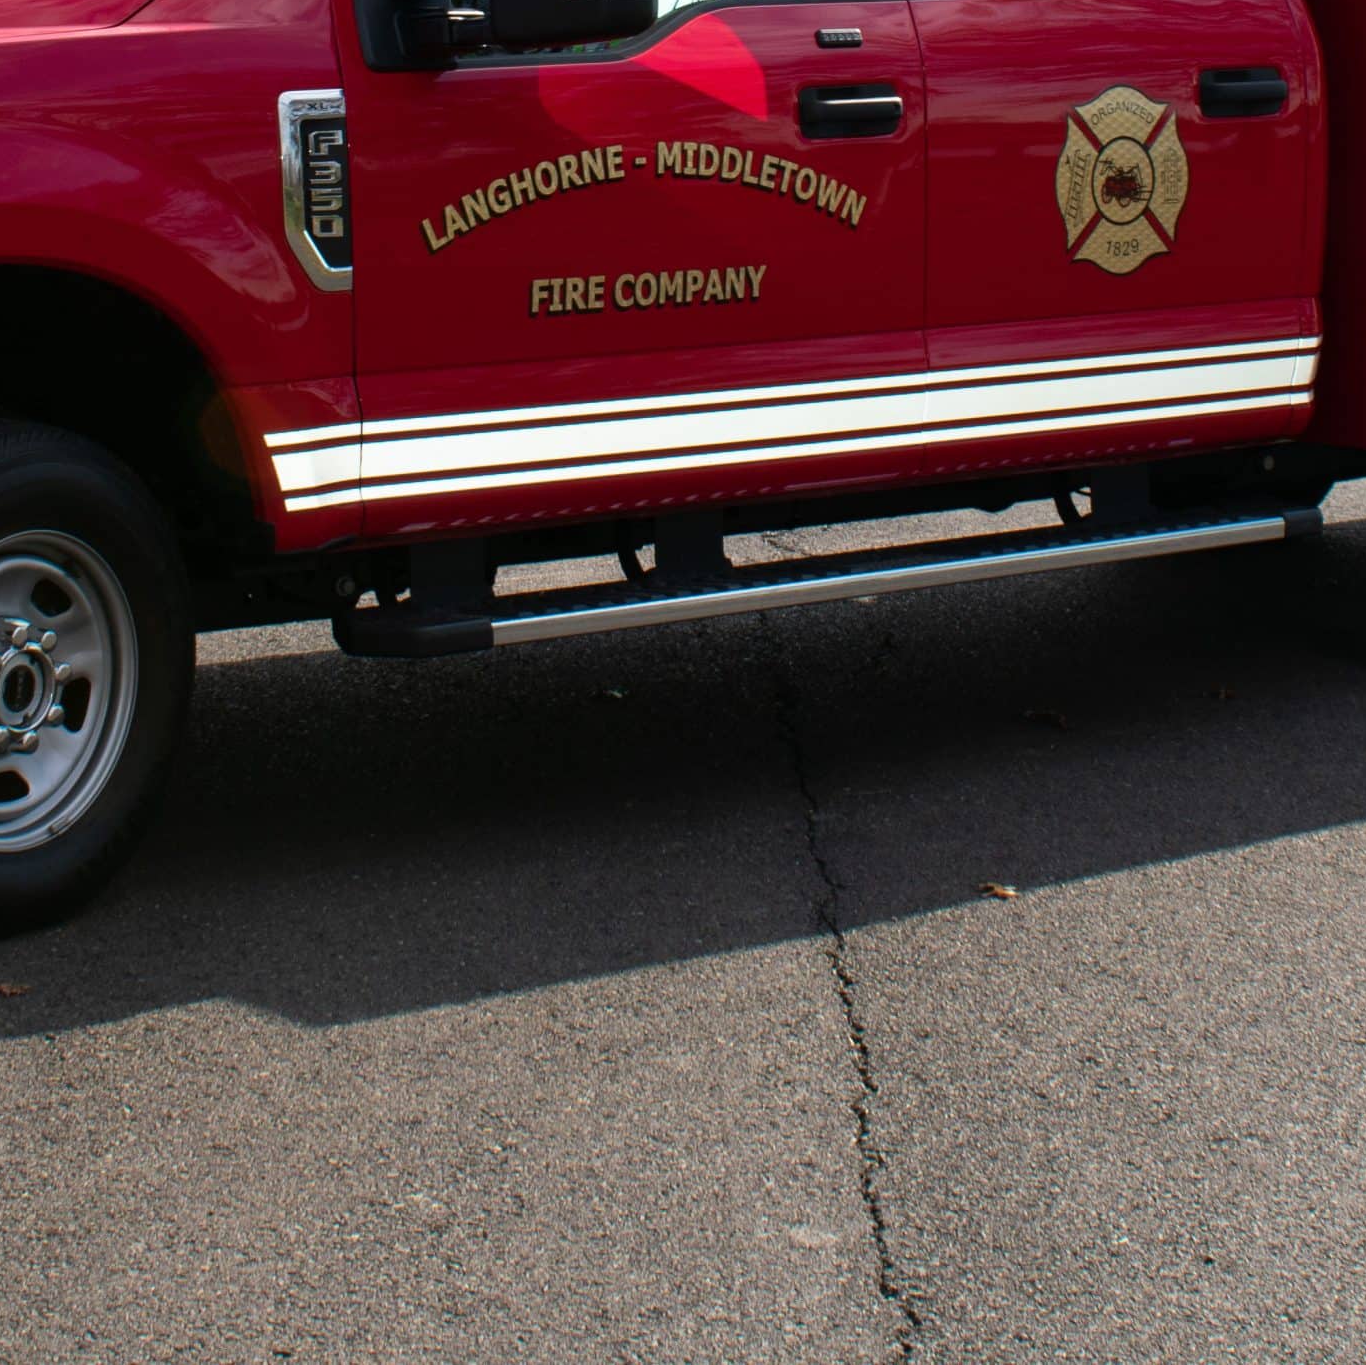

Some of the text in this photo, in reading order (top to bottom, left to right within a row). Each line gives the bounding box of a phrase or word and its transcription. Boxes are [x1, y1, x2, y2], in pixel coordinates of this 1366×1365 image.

[1090, 100, 1155, 126] ORGANIZED
[420, 144, 625, 253] LANGHORNE
[657, 141, 867, 227] MIDDLETOWN
[1106, 239, 1140, 257] 1829
[530, 265, 767, 315] FIRE COMPANY
